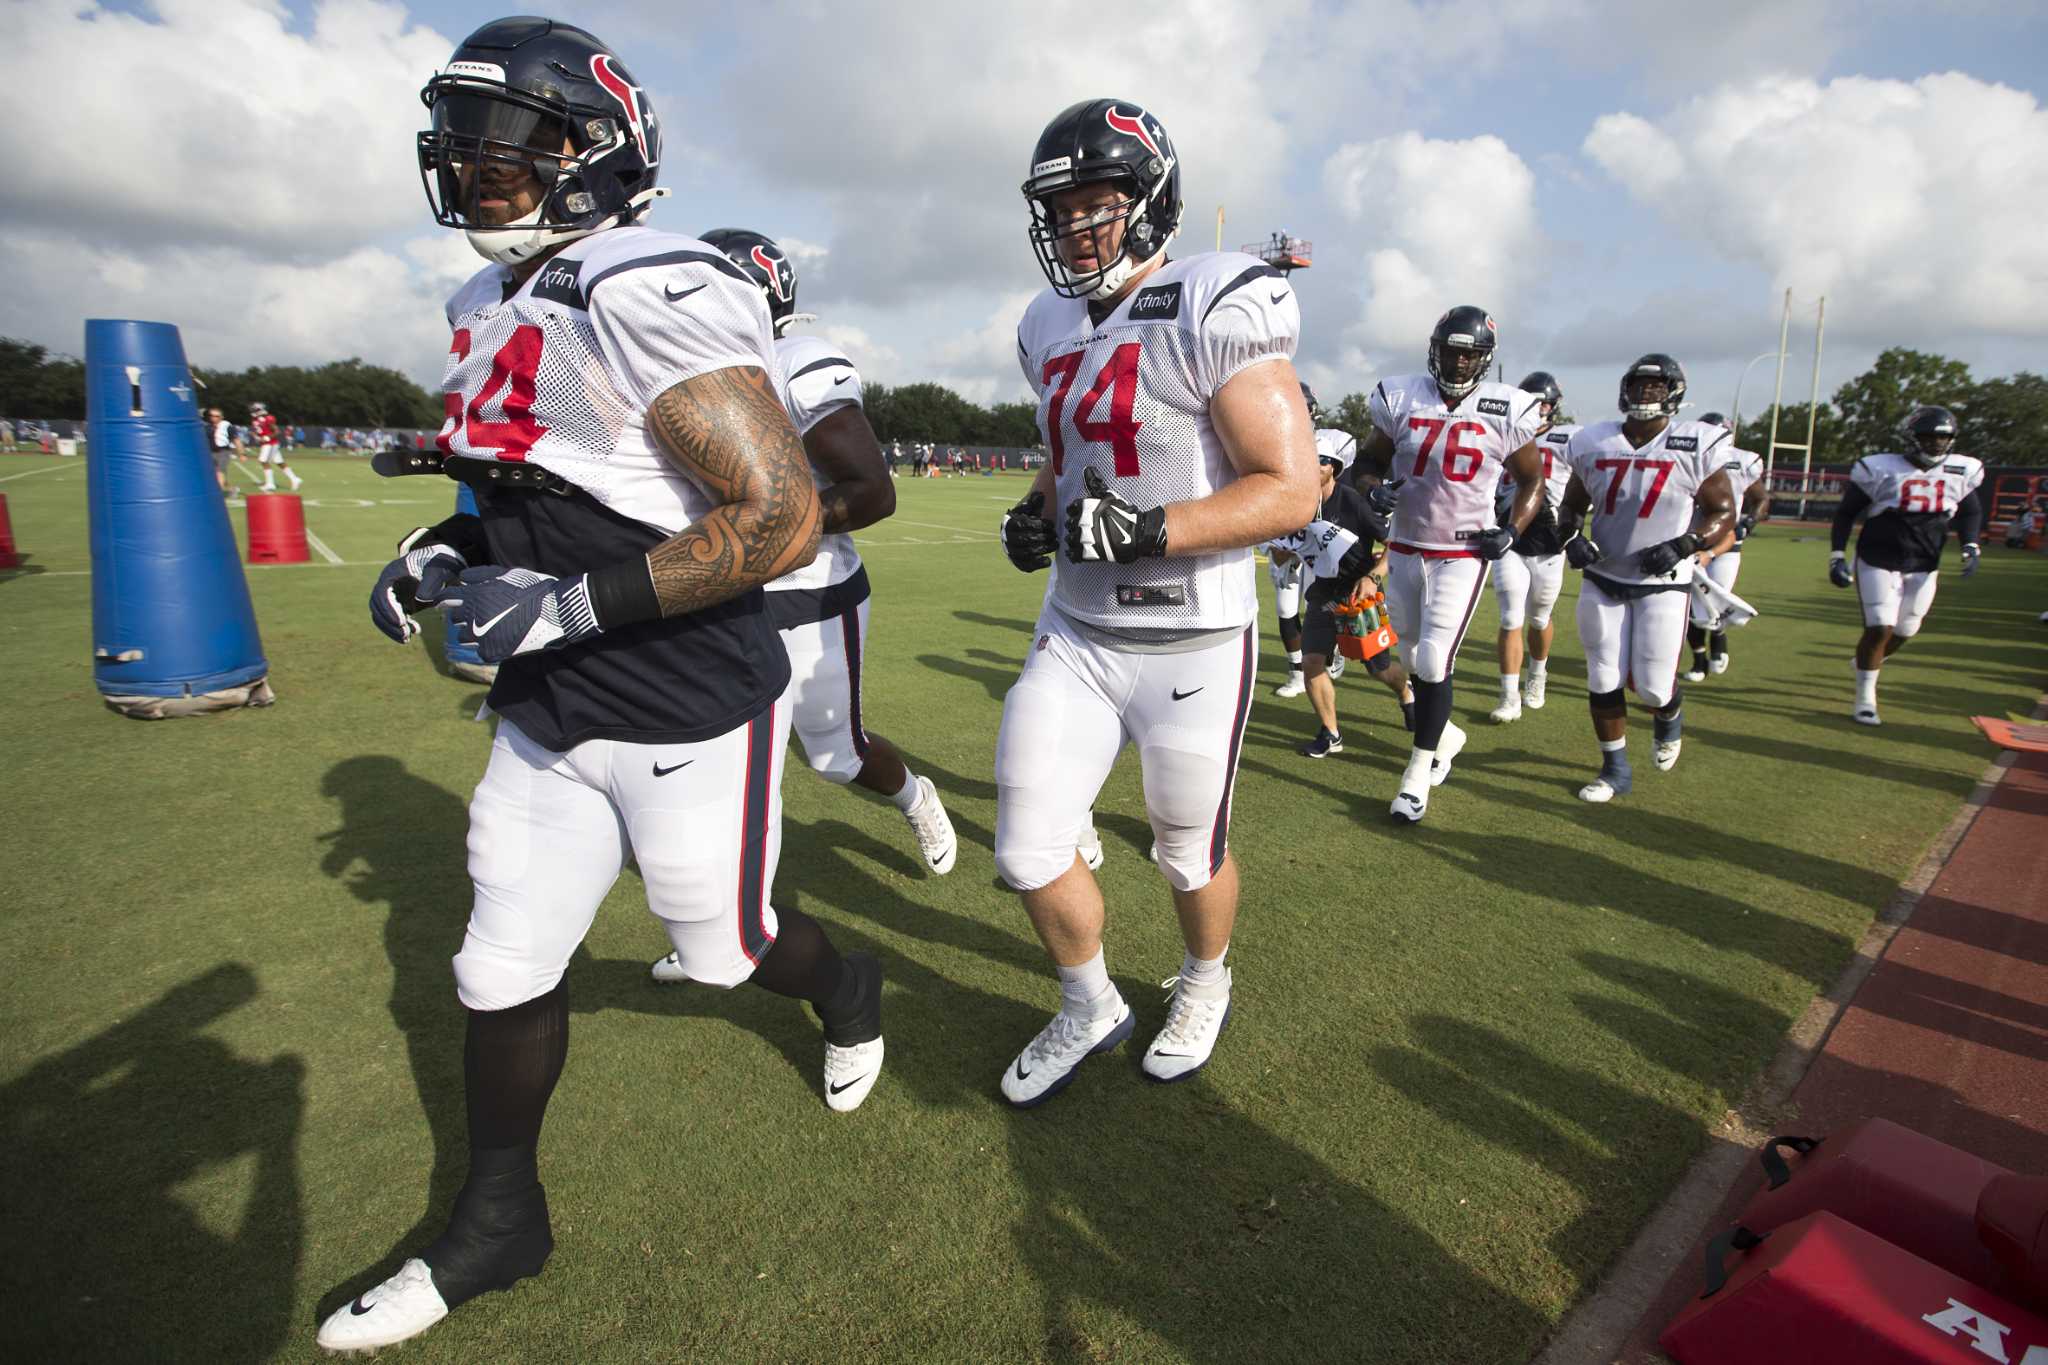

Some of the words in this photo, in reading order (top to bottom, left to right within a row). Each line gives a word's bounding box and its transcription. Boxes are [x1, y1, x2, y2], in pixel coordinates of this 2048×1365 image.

[452, 64, 493, 72] TEXANS
[1036, 161, 1068, 173] TEXANS
[1136, 293, 1177, 312] xfinity
[1073, 333, 1108, 347] TEXANS
[1042, 342, 1143, 477] 74
[1480, 400, 1507, 412] xfinity
[1408, 416, 1487, 482] 76
[1595, 459, 1676, 518] 77
[1901, 479, 1946, 513] 61
